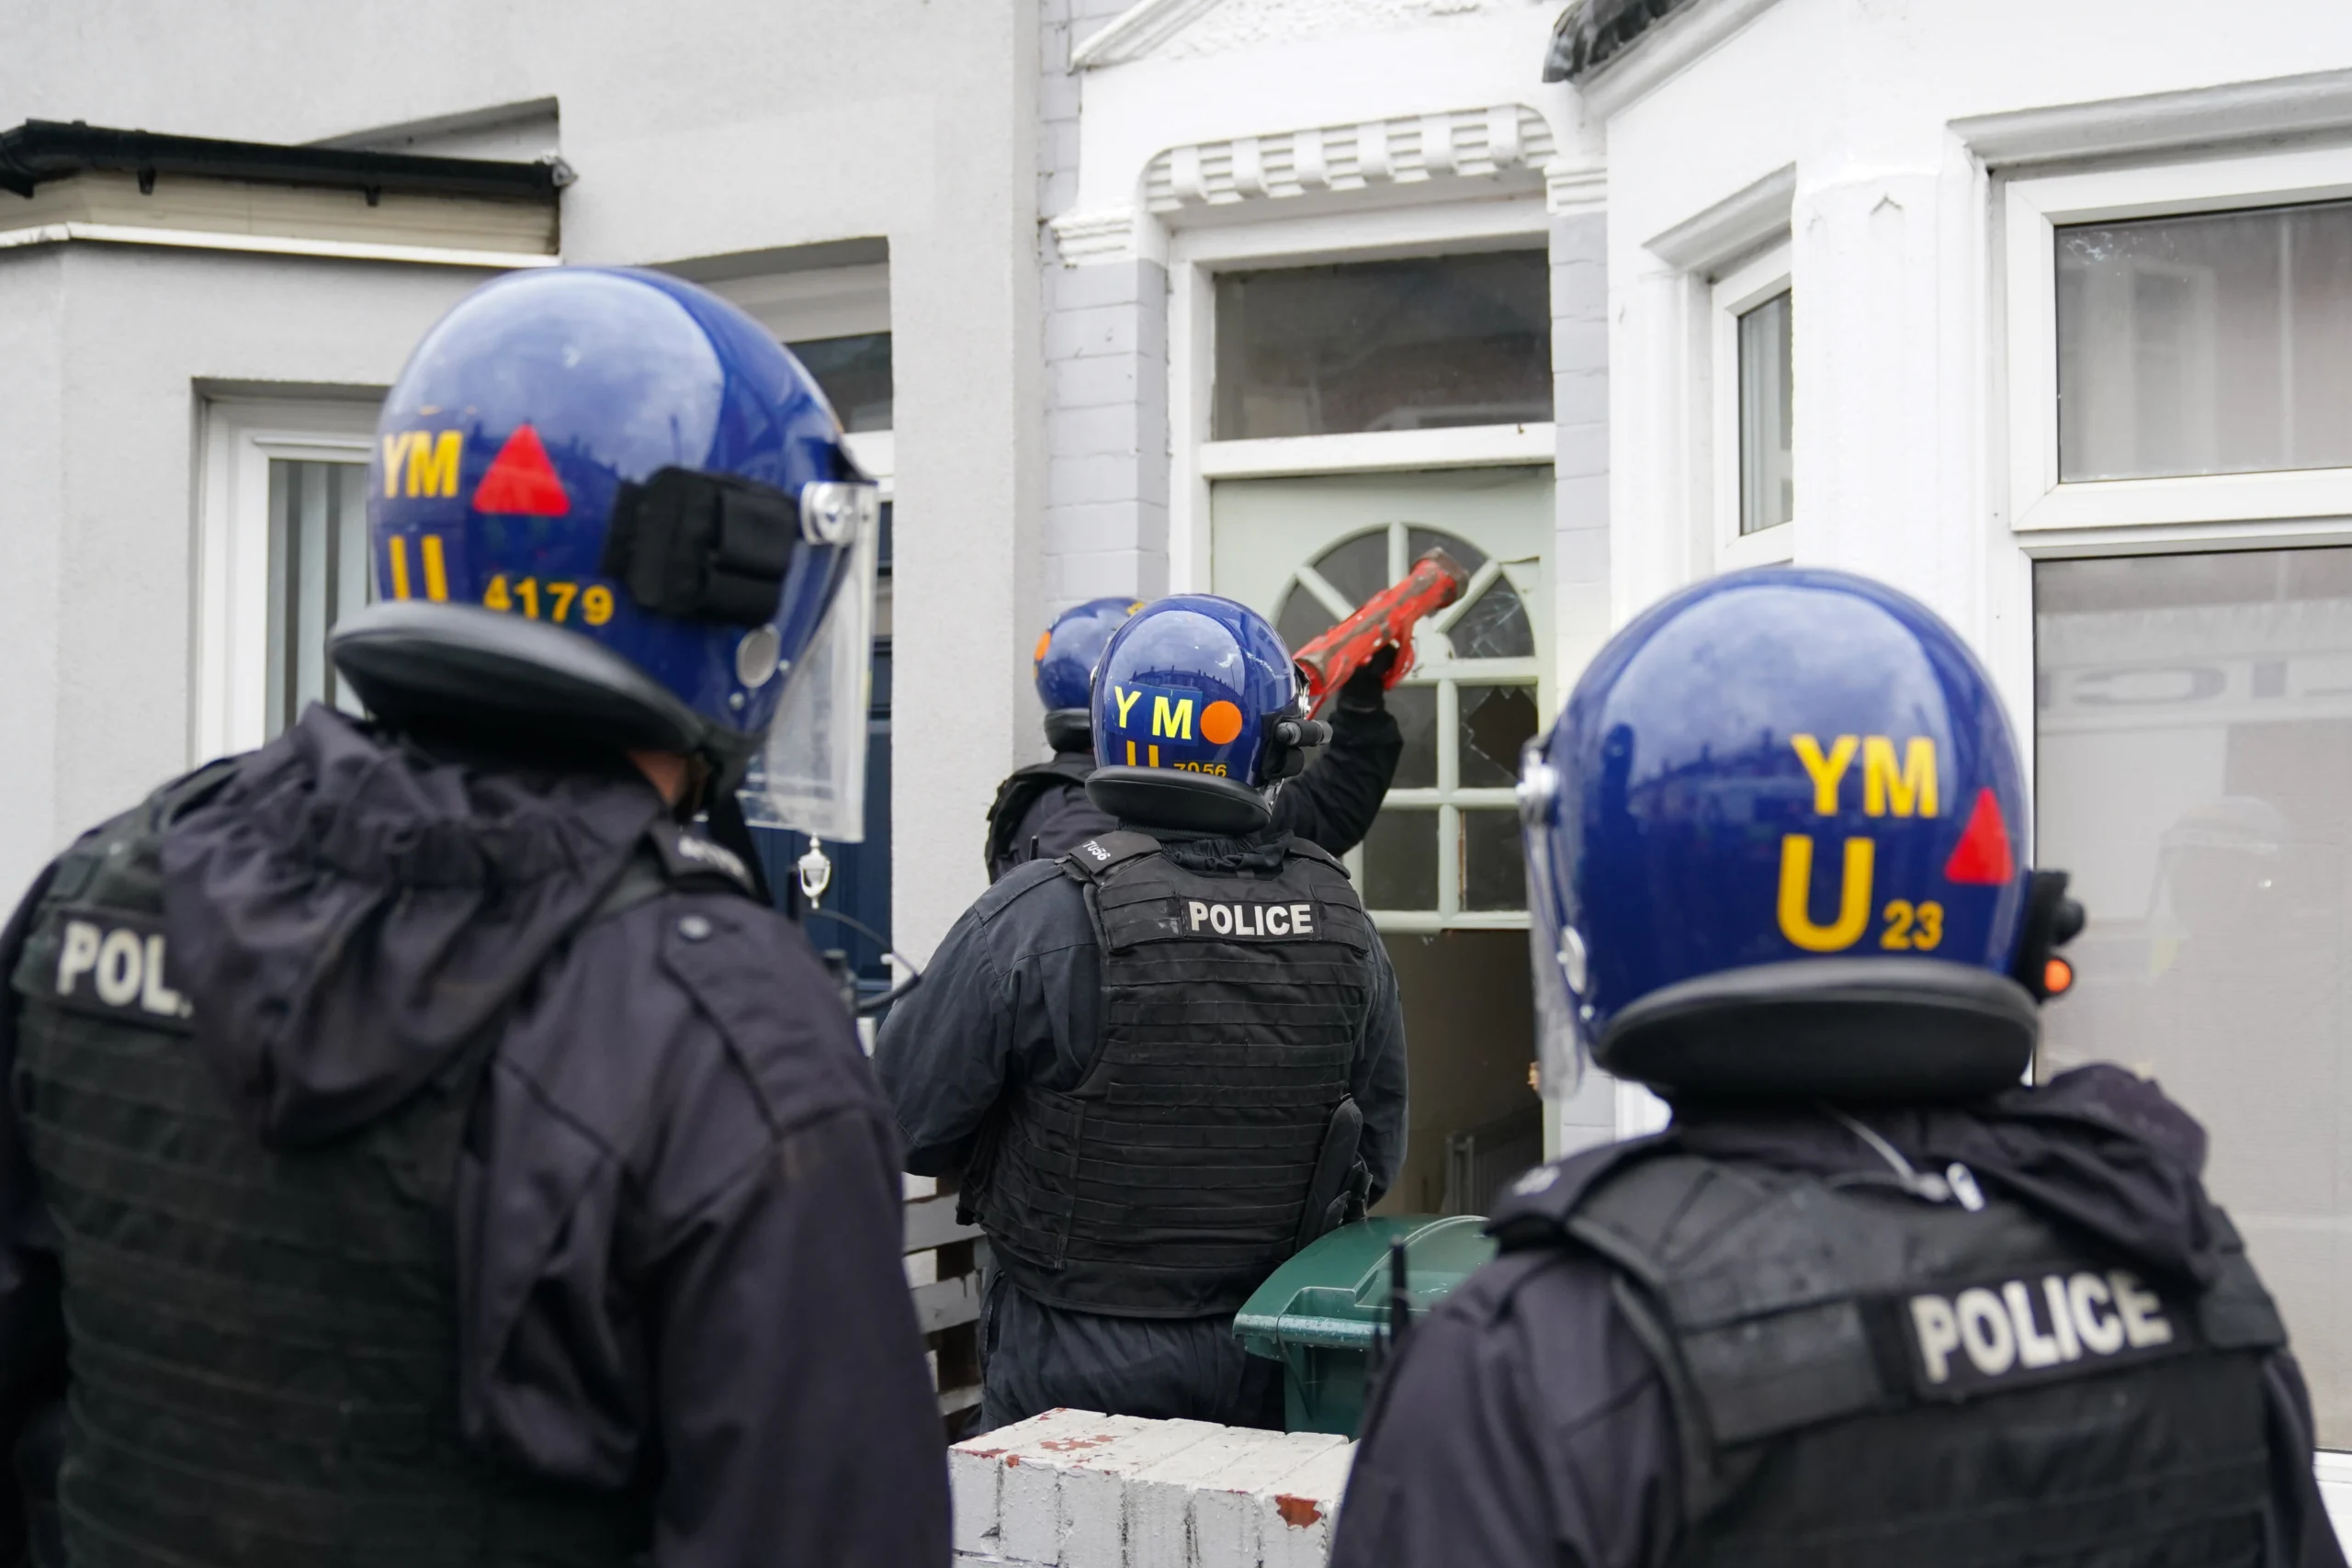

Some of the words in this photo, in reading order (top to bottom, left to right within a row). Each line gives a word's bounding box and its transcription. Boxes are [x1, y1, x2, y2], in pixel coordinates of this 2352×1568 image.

[382, 429, 464, 498] YM
[483, 574, 615, 626] 4179
[1790, 734, 1939, 818] YM
[1188, 901, 1314, 936] POLICE
[1777, 833, 1876, 952] U
[1879, 899, 1945, 951] 23
[55, 919, 194, 1020] POL
[1909, 1268, 2174, 1383] POLICE
